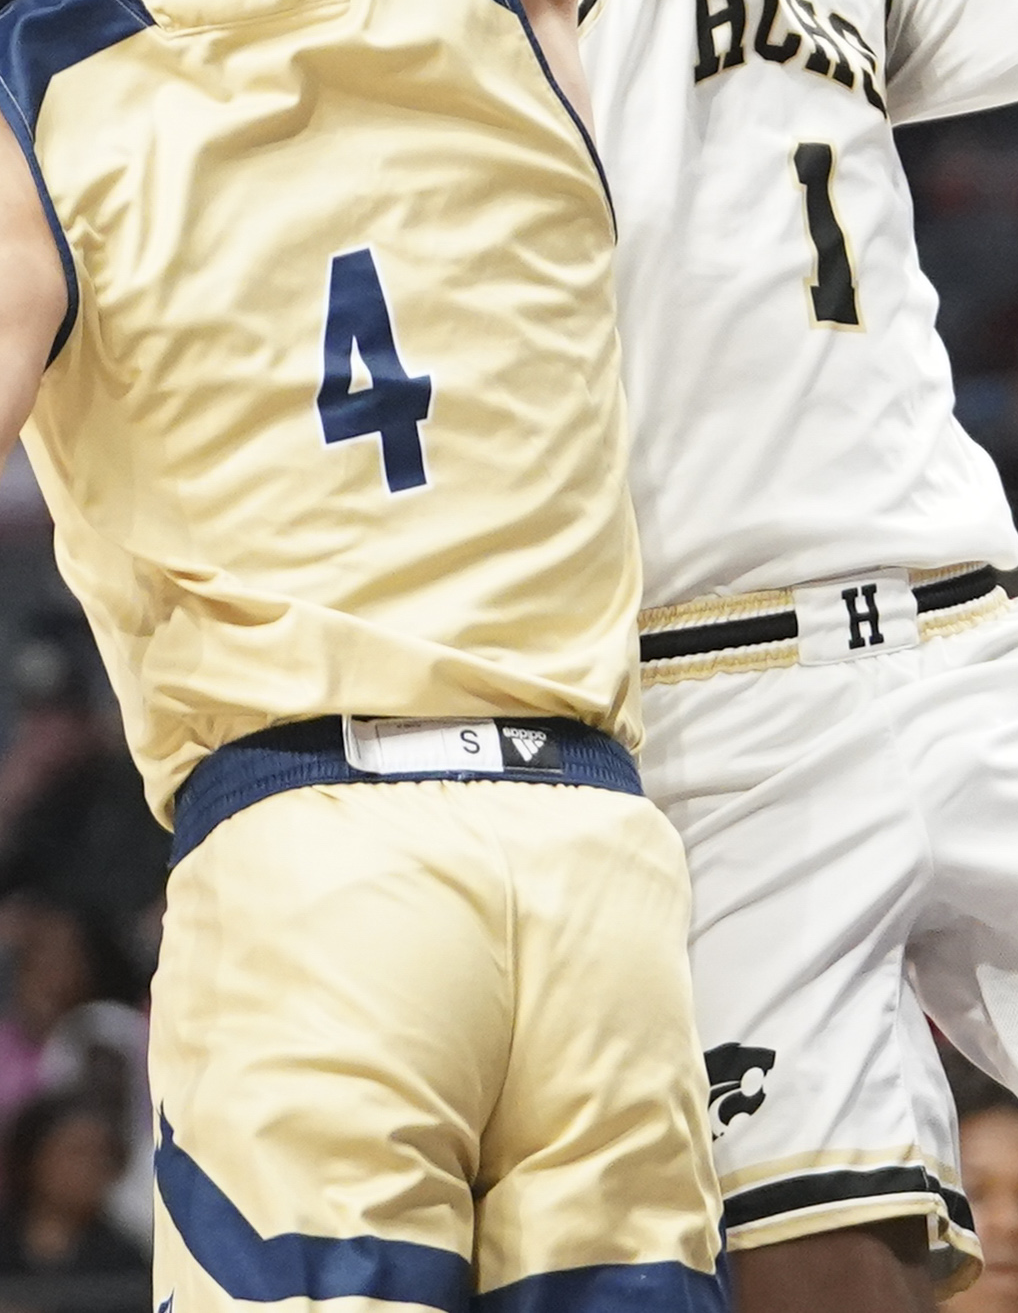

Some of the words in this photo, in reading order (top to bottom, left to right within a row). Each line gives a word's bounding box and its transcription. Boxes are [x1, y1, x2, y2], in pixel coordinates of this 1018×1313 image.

[794, 142, 860, 325] 1
[316, 246, 433, 494] 4
[841, 583, 884, 650] H
[459, 729, 481, 755] S
